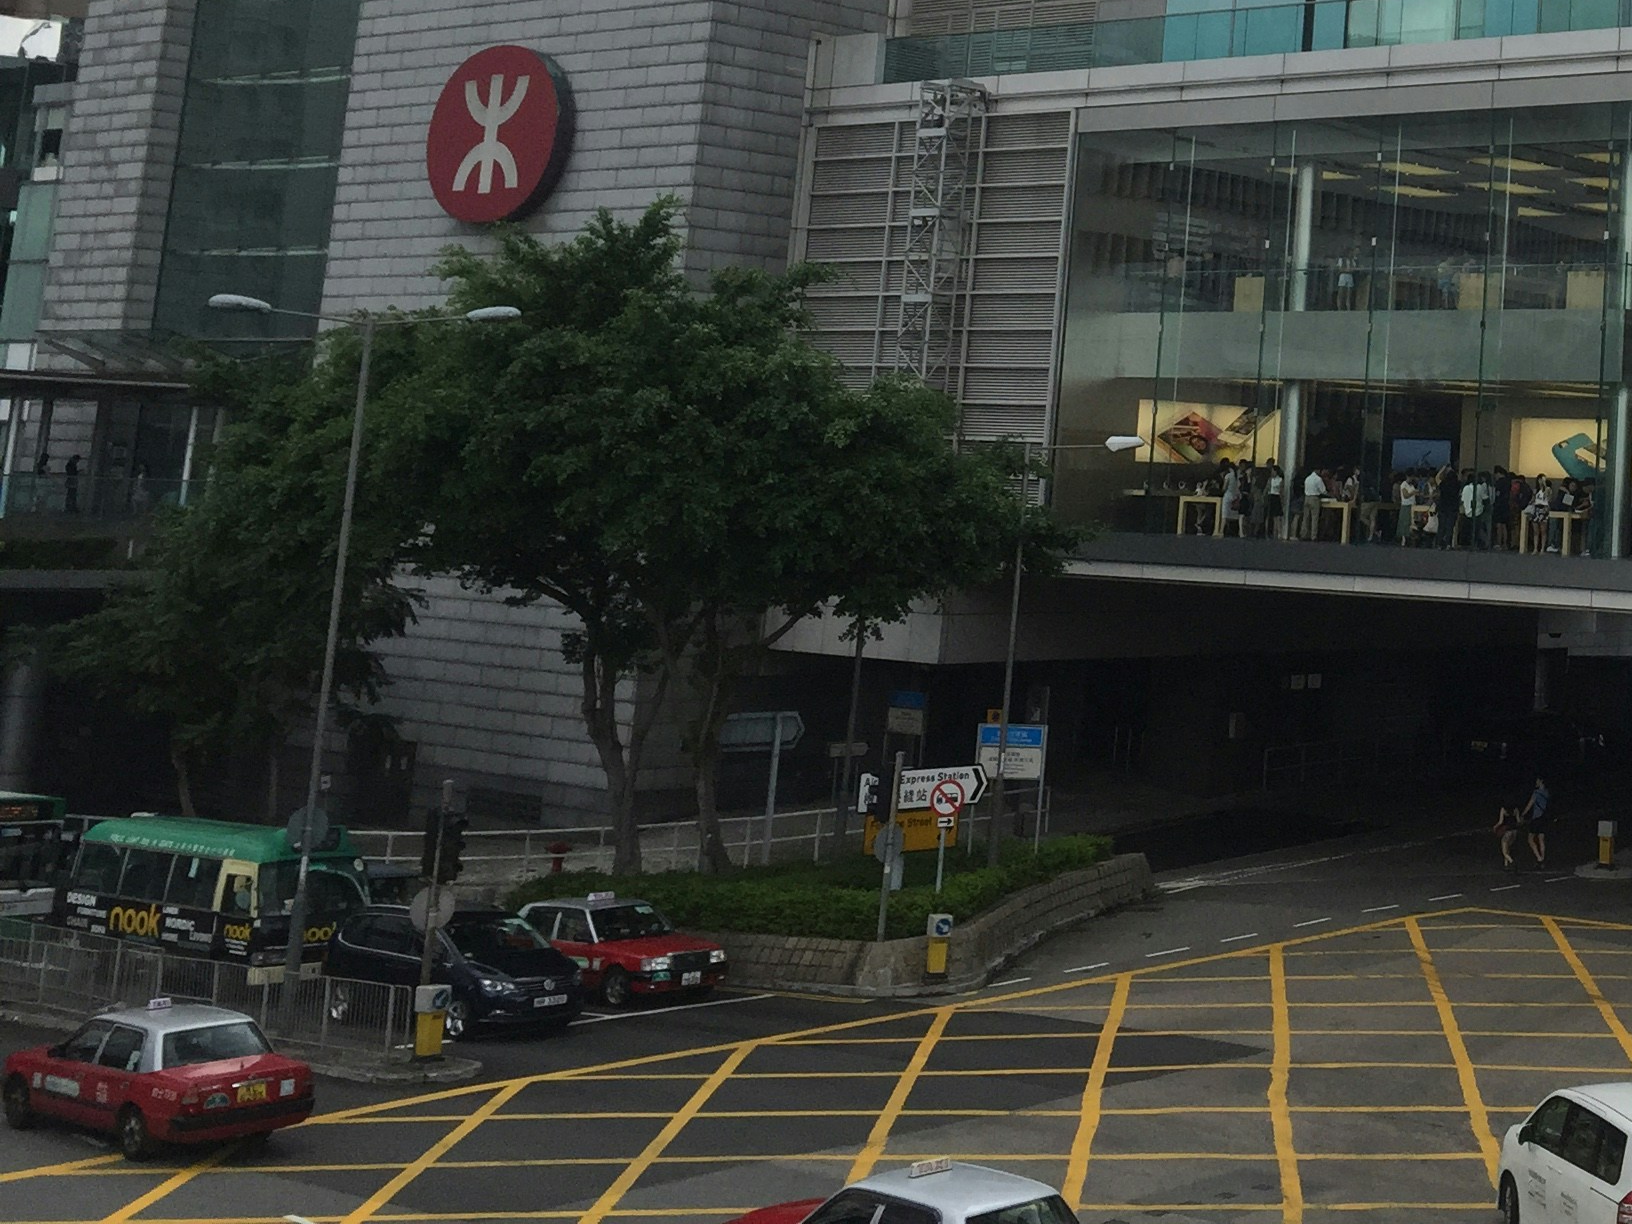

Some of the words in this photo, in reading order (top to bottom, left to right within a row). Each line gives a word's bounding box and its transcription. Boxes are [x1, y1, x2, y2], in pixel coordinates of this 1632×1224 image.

[900, 774, 936, 787] Express
[937, 771, 970, 782] Station
[907, 816, 932, 828] Street
[109, 903, 162, 939] nook
[223, 922, 252, 941] nook
[303, 921, 337, 942] oo
